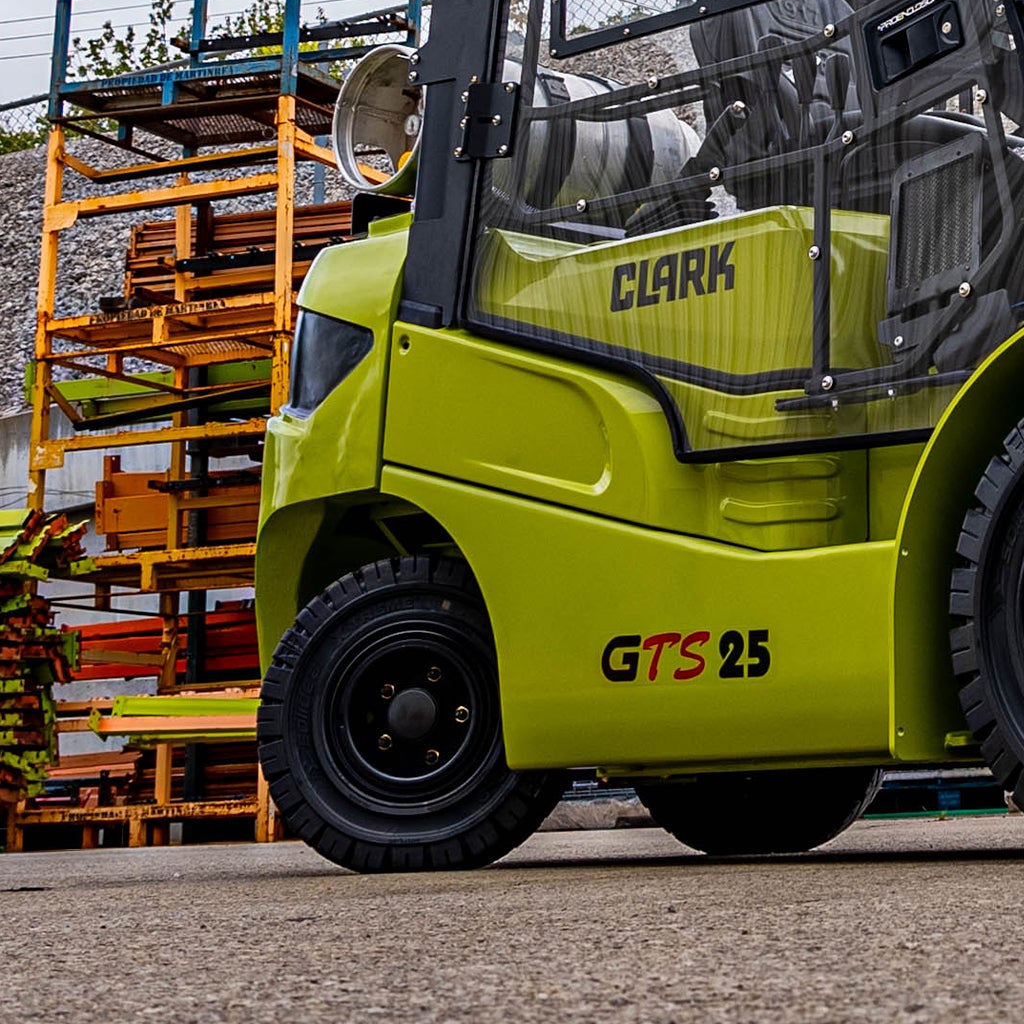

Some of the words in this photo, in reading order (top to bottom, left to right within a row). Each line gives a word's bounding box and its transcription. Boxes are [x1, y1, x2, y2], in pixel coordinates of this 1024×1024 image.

[610, 240, 736, 312] CLARK
[601, 631, 711, 682] GTS
[718, 629, 771, 678] 25
